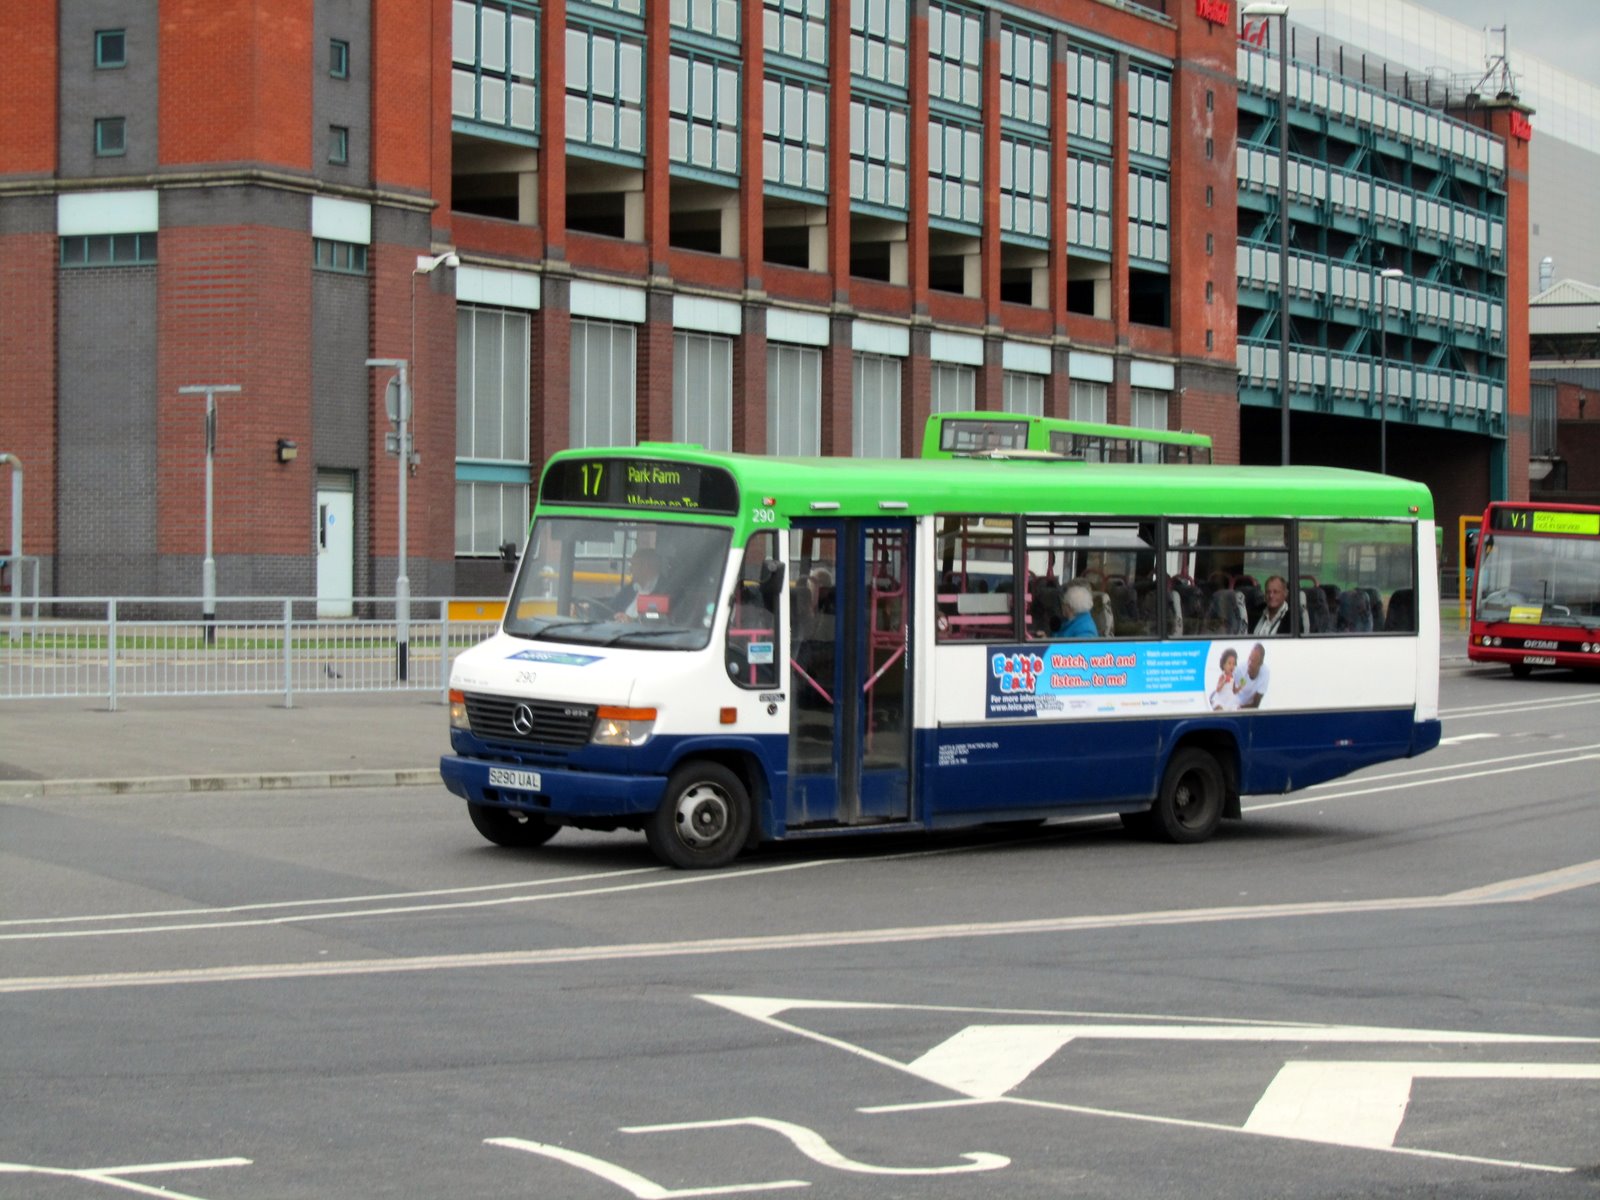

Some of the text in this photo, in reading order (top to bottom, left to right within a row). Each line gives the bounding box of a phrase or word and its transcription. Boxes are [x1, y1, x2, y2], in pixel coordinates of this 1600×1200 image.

[581, 463, 603, 496] 17
[628, 466, 680, 485] Park Farm
[752, 509, 775, 523] 290
[1523, 640, 1559, 650] OPTARE
[992, 653, 1044, 677] Babble
[1051, 653, 1136, 669] Watch, wait and
[515, 671, 537, 685] 290
[1000, 672, 1036, 693] Back
[1051, 672, 1127, 689] listen... to me!
[490, 770, 540, 788] S290 UAL
